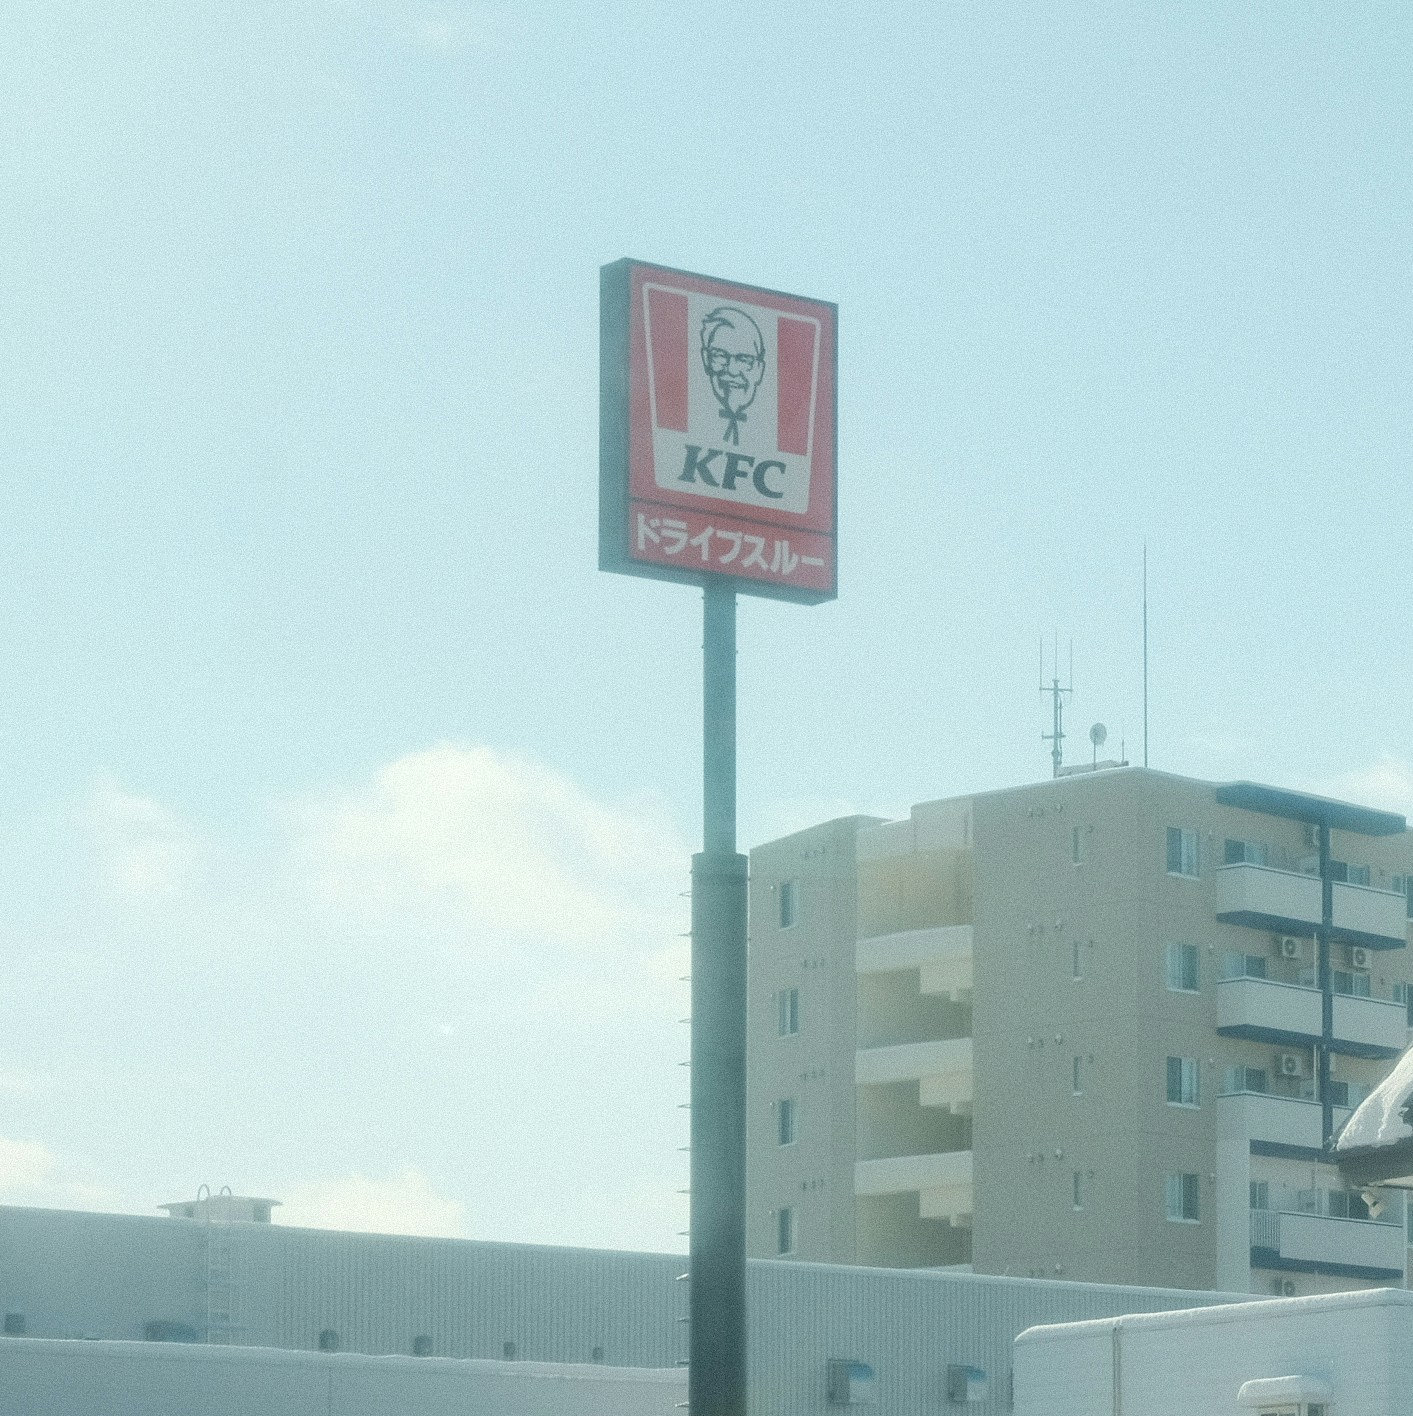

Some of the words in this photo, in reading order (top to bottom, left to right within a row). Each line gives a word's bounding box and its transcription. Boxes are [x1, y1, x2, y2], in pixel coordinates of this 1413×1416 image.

[677, 444, 786, 499] KFC
[636, 513, 826, 574] ドライブスルー
